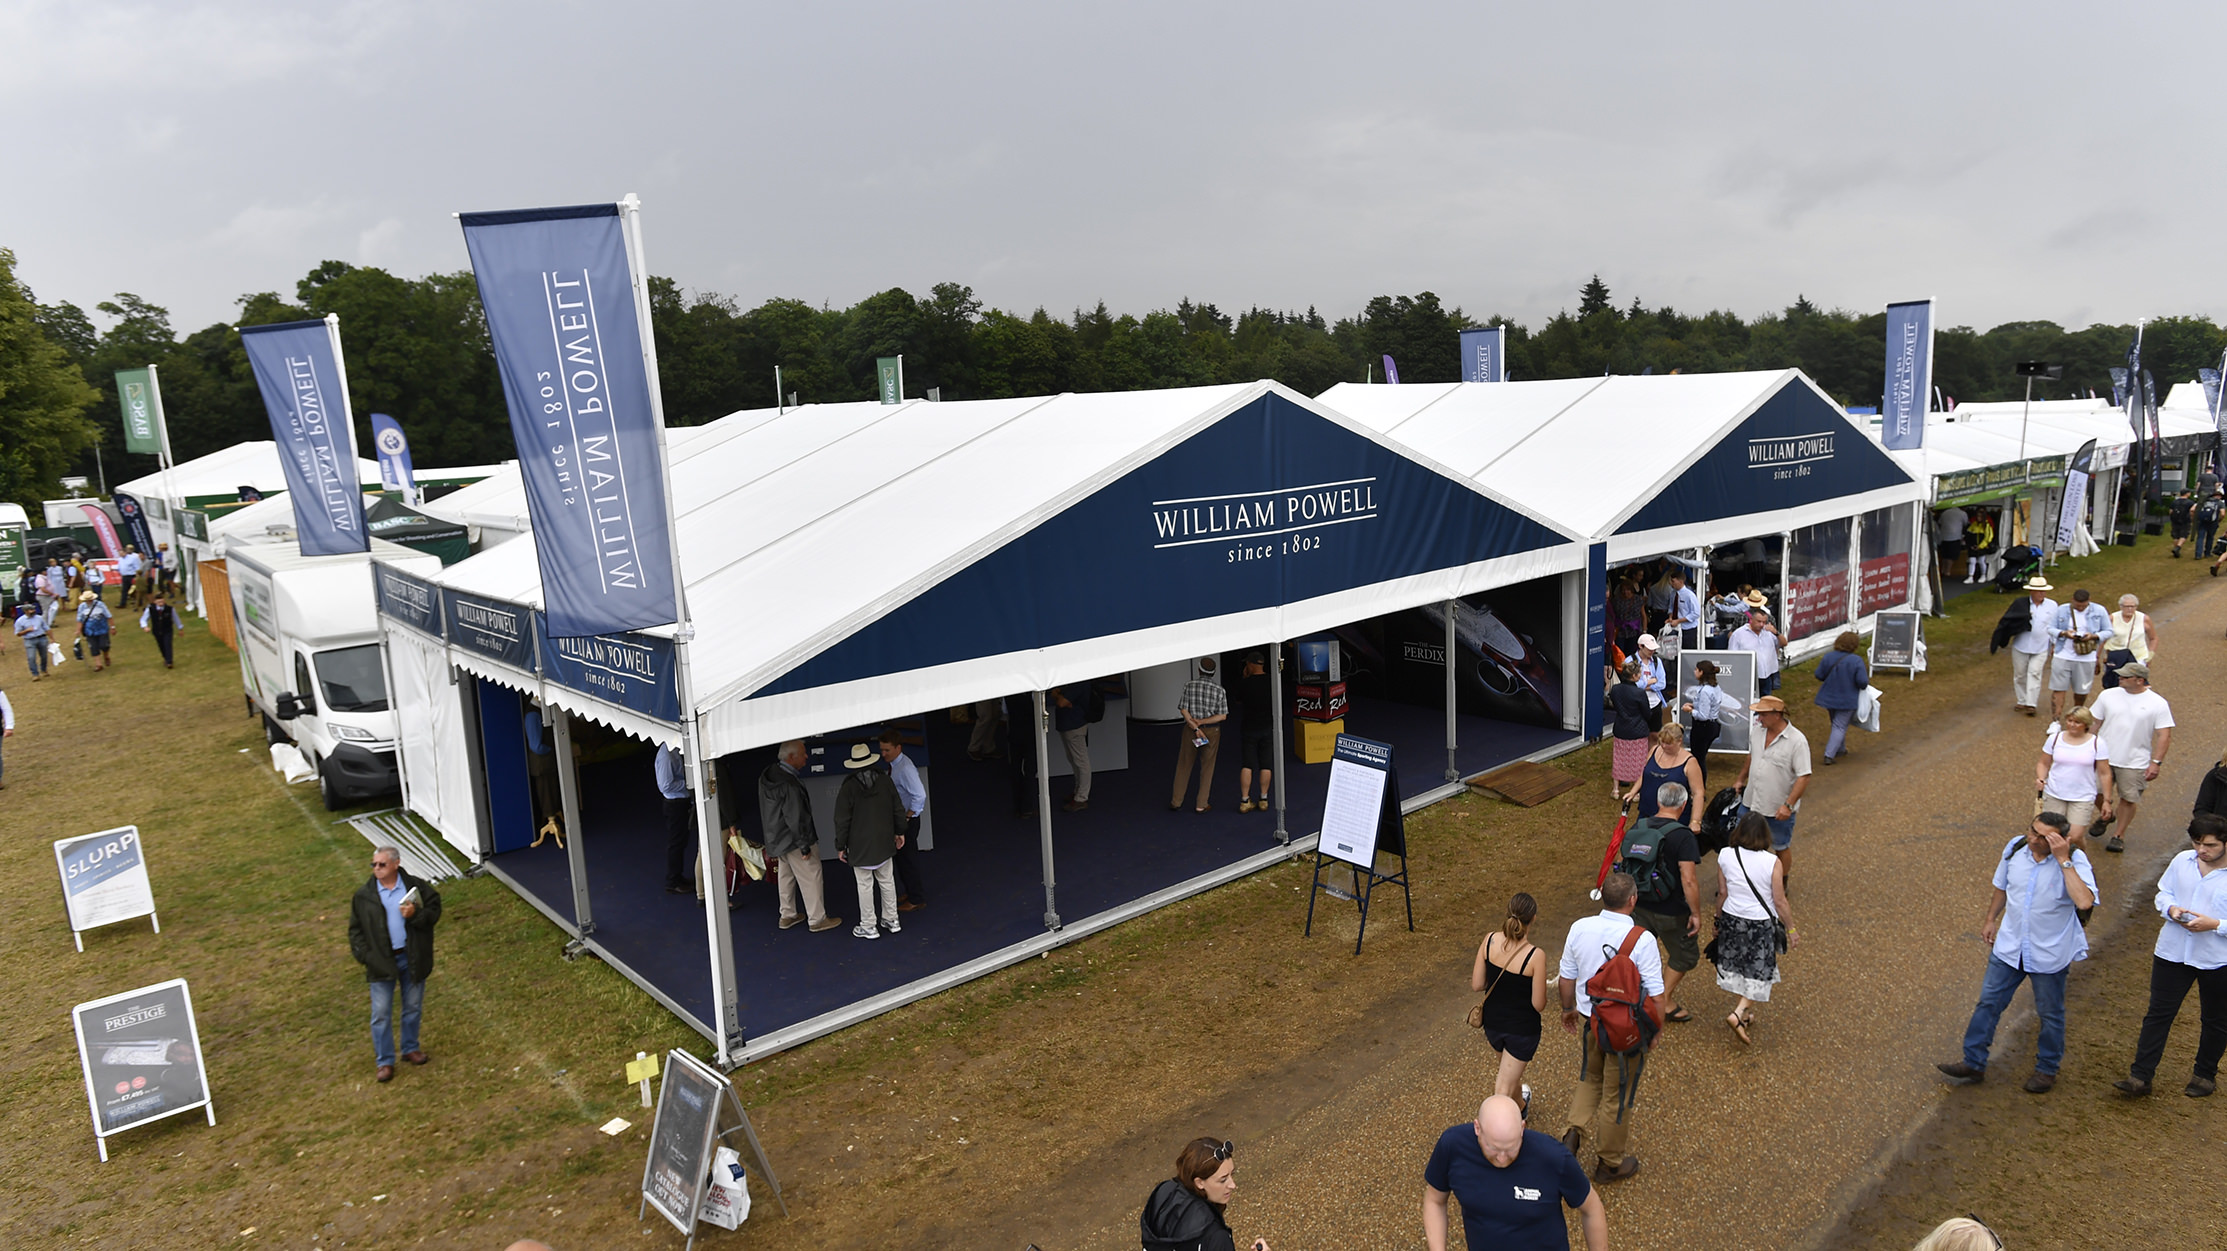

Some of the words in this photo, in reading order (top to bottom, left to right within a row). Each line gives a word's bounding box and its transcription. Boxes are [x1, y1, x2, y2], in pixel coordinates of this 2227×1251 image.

[1748, 443, 1795, 462] WILLIAM
[1798, 437, 1835, 456] POWELL
[1773, 468, 1792, 480] since
[1794, 464, 1811, 478] 1802
[372, 517, 409, 530] BASC
[1153, 500, 1275, 538] WILLIAM
[1287, 486, 1377, 522] POWELL
[1228, 543, 1273, 563] since
[1282, 534, 1320, 555] 1802
[456, 603, 487, 626] WILLIAM
[488, 613, 518, 635] POWELL
[475, 634, 489, 648] since
[489, 639, 502, 652] 1802
[1404, 646, 1444, 662] PERDIX
[558, 637, 605, 663] WILLIAM
[607, 645, 655, 677] POWELL
[585, 669, 605, 686] since
[607, 675, 625, 694] 1802
[1296, 696, 1323, 713] Red
[1329, 692, 1347, 715] Red
[1337, 739, 1363, 750] WILLIAM
[1365, 746, 1388, 756] POWELL
[68, 833, 135, 879] SLURP
[105, 1005, 167, 1030] PRESTIGE
[667, 1168, 682, 1185] NEW
[654, 1183, 669, 1200] OUT
[655, 1171, 690, 1208] CATALOGUE
